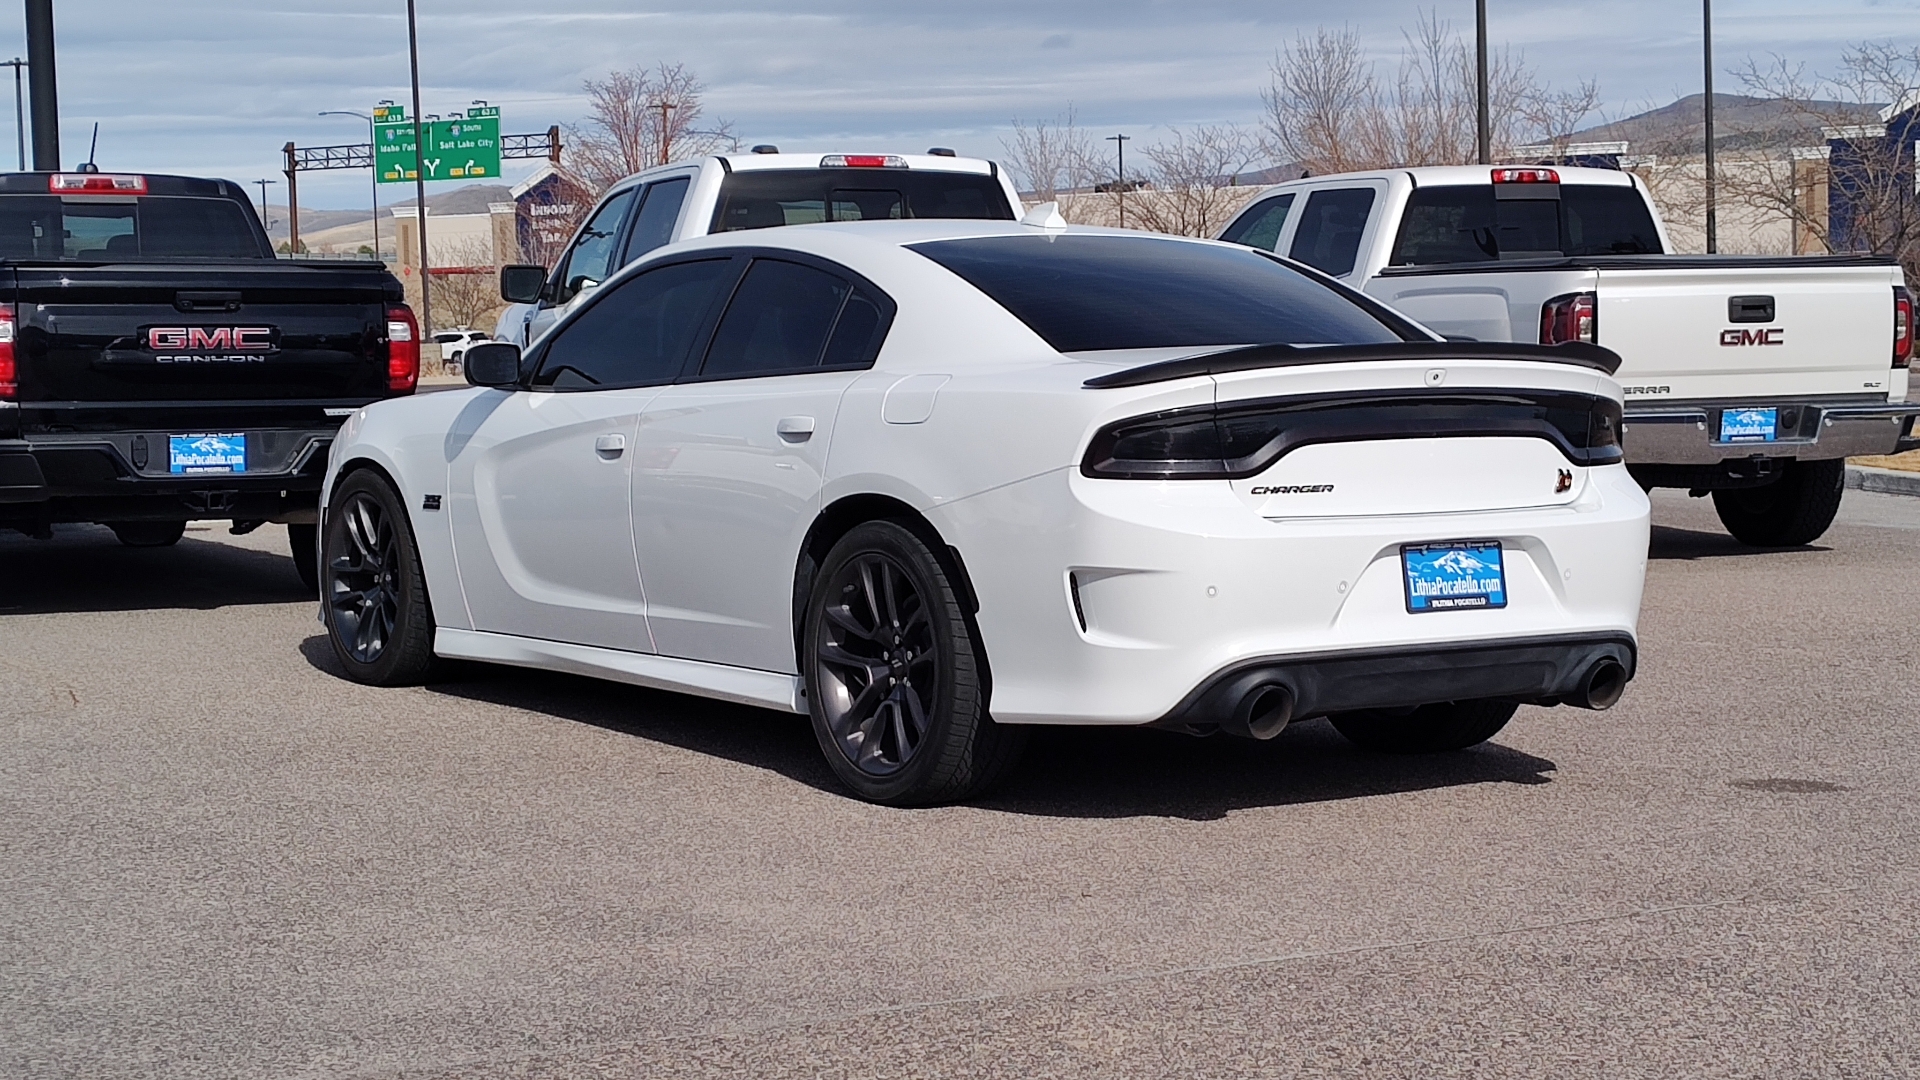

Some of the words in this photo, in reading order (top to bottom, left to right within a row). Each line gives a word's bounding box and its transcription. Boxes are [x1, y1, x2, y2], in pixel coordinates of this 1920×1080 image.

[380, 145, 400, 153] Idaho
[402, 143, 417, 152] Fall
[439, 141, 455, 150] Salt
[457, 140, 475, 149] Lake
[477, 138, 494, 148] City
[149, 327, 270, 349] GMC
[1719, 328, 1784, 346] GMC
[156, 355, 265, 363] CANYON
[1623, 386, 1670, 394] ERRA
[1250, 484, 1335, 495] CHARGER
[1410, 575, 1501, 596] LithiaPocatello.com
